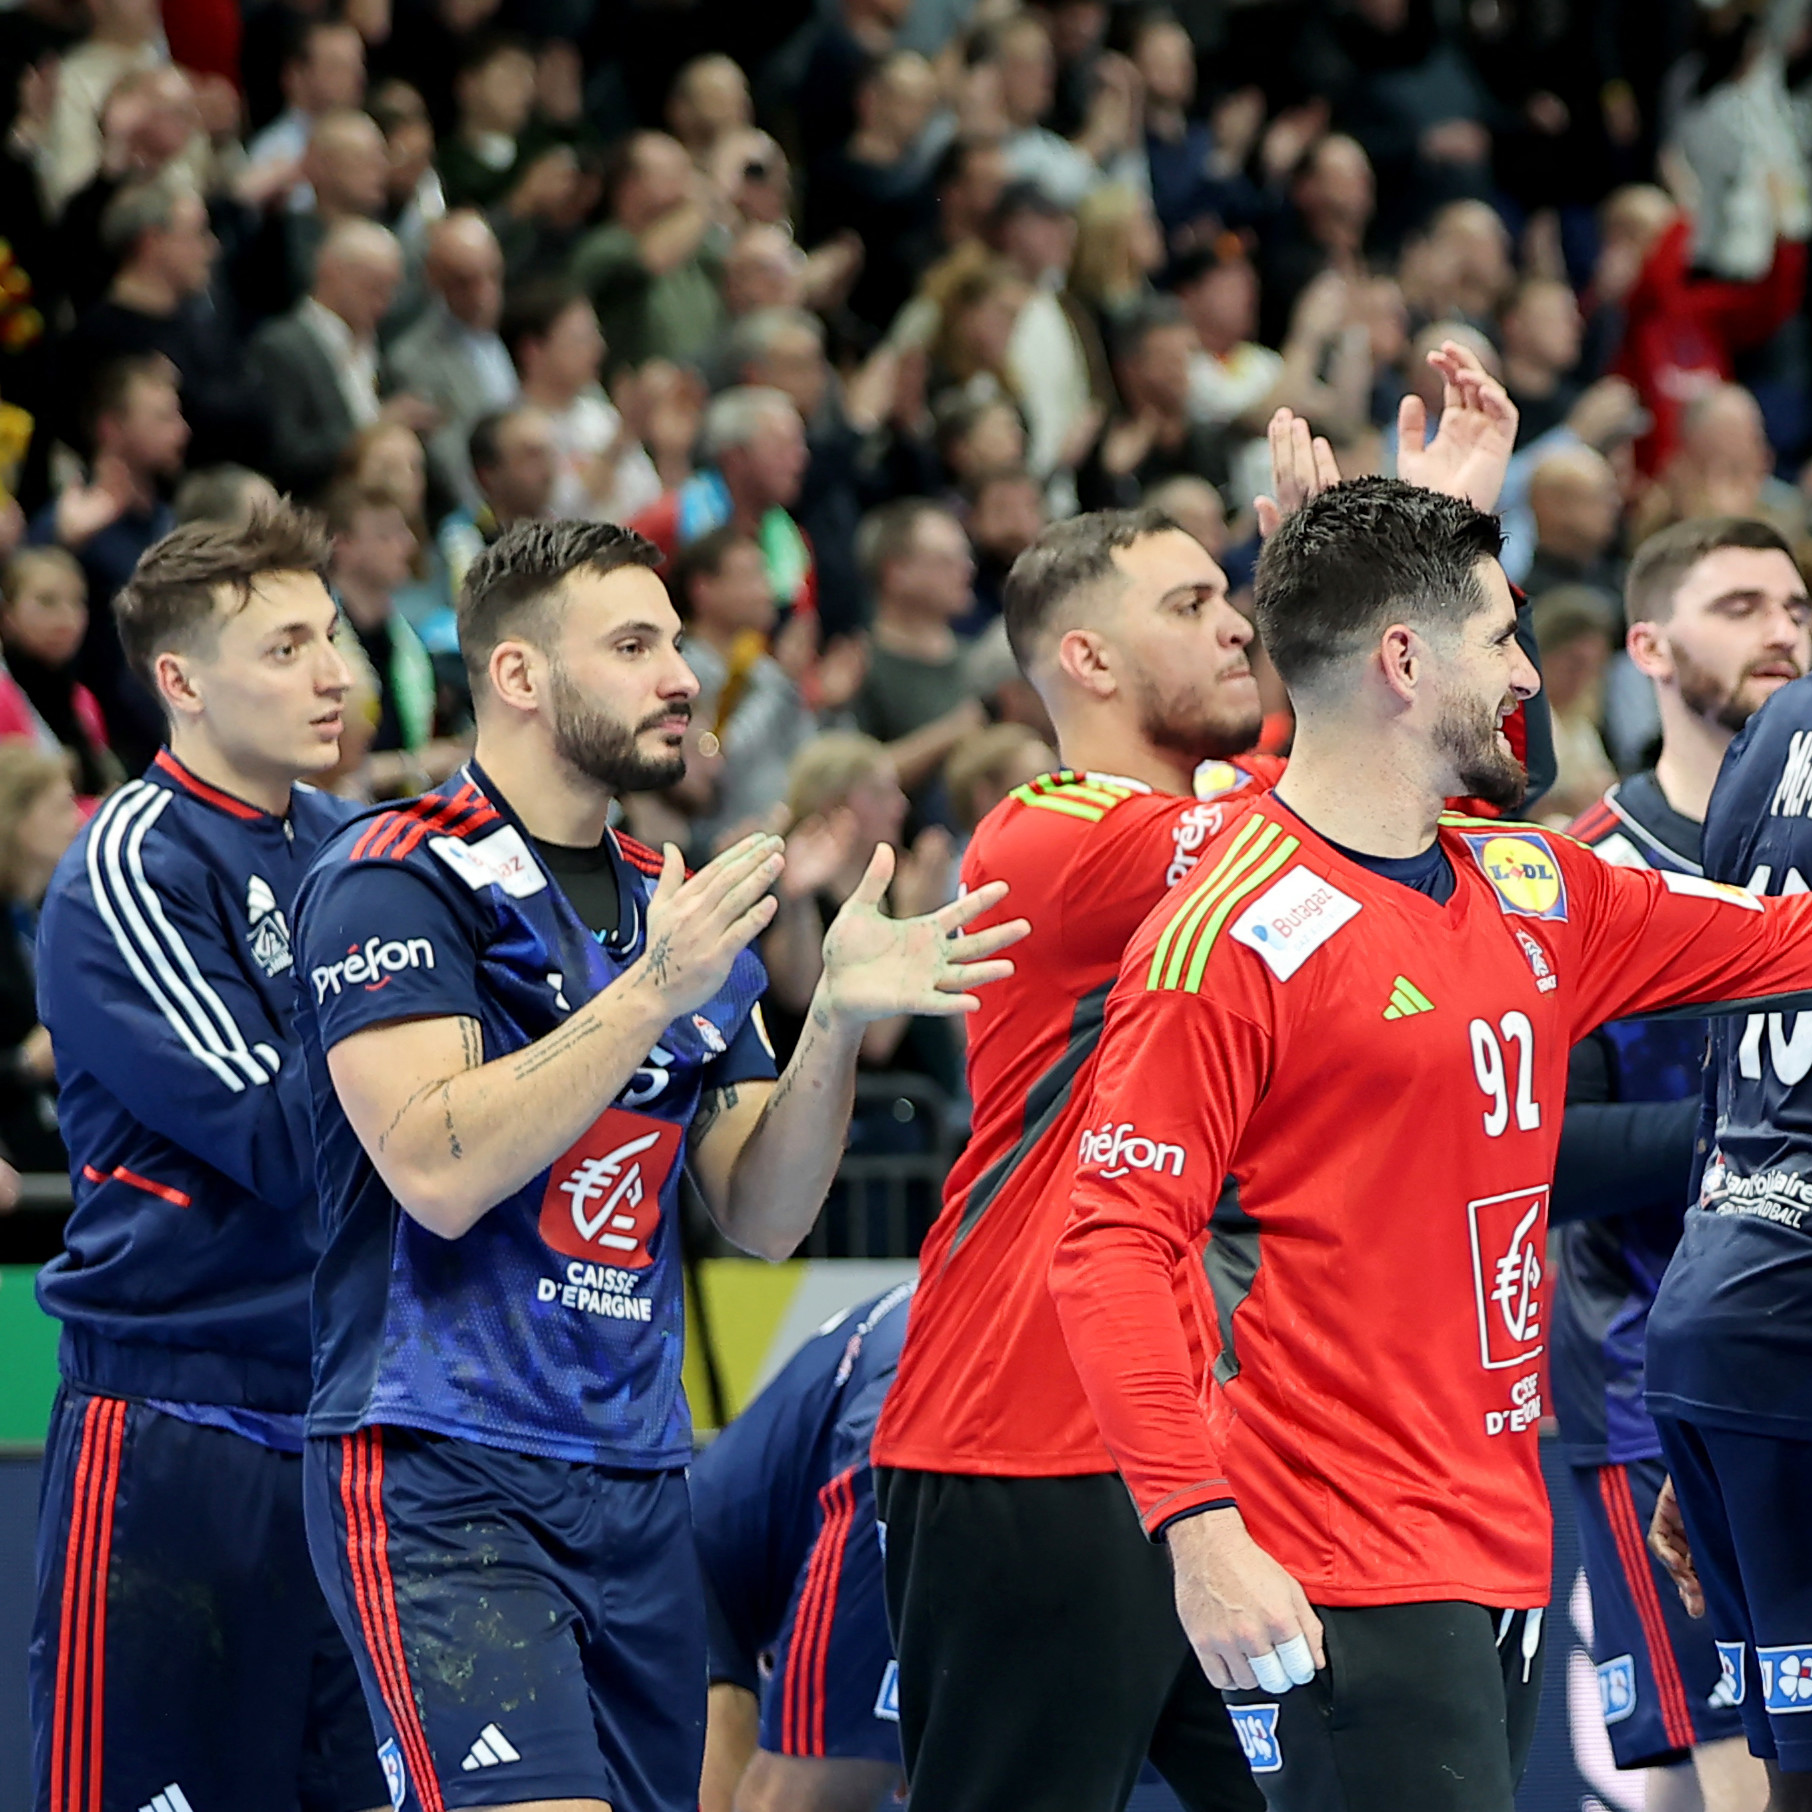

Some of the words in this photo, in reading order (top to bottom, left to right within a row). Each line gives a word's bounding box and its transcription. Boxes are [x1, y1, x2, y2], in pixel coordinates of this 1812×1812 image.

[1271, 887, 1334, 939] Butagaz
[1469, 1010, 1541, 1137] 92
[537, 1278, 653, 1322] D'EPARGNE
[566, 1261, 639, 1295] CAISSE
